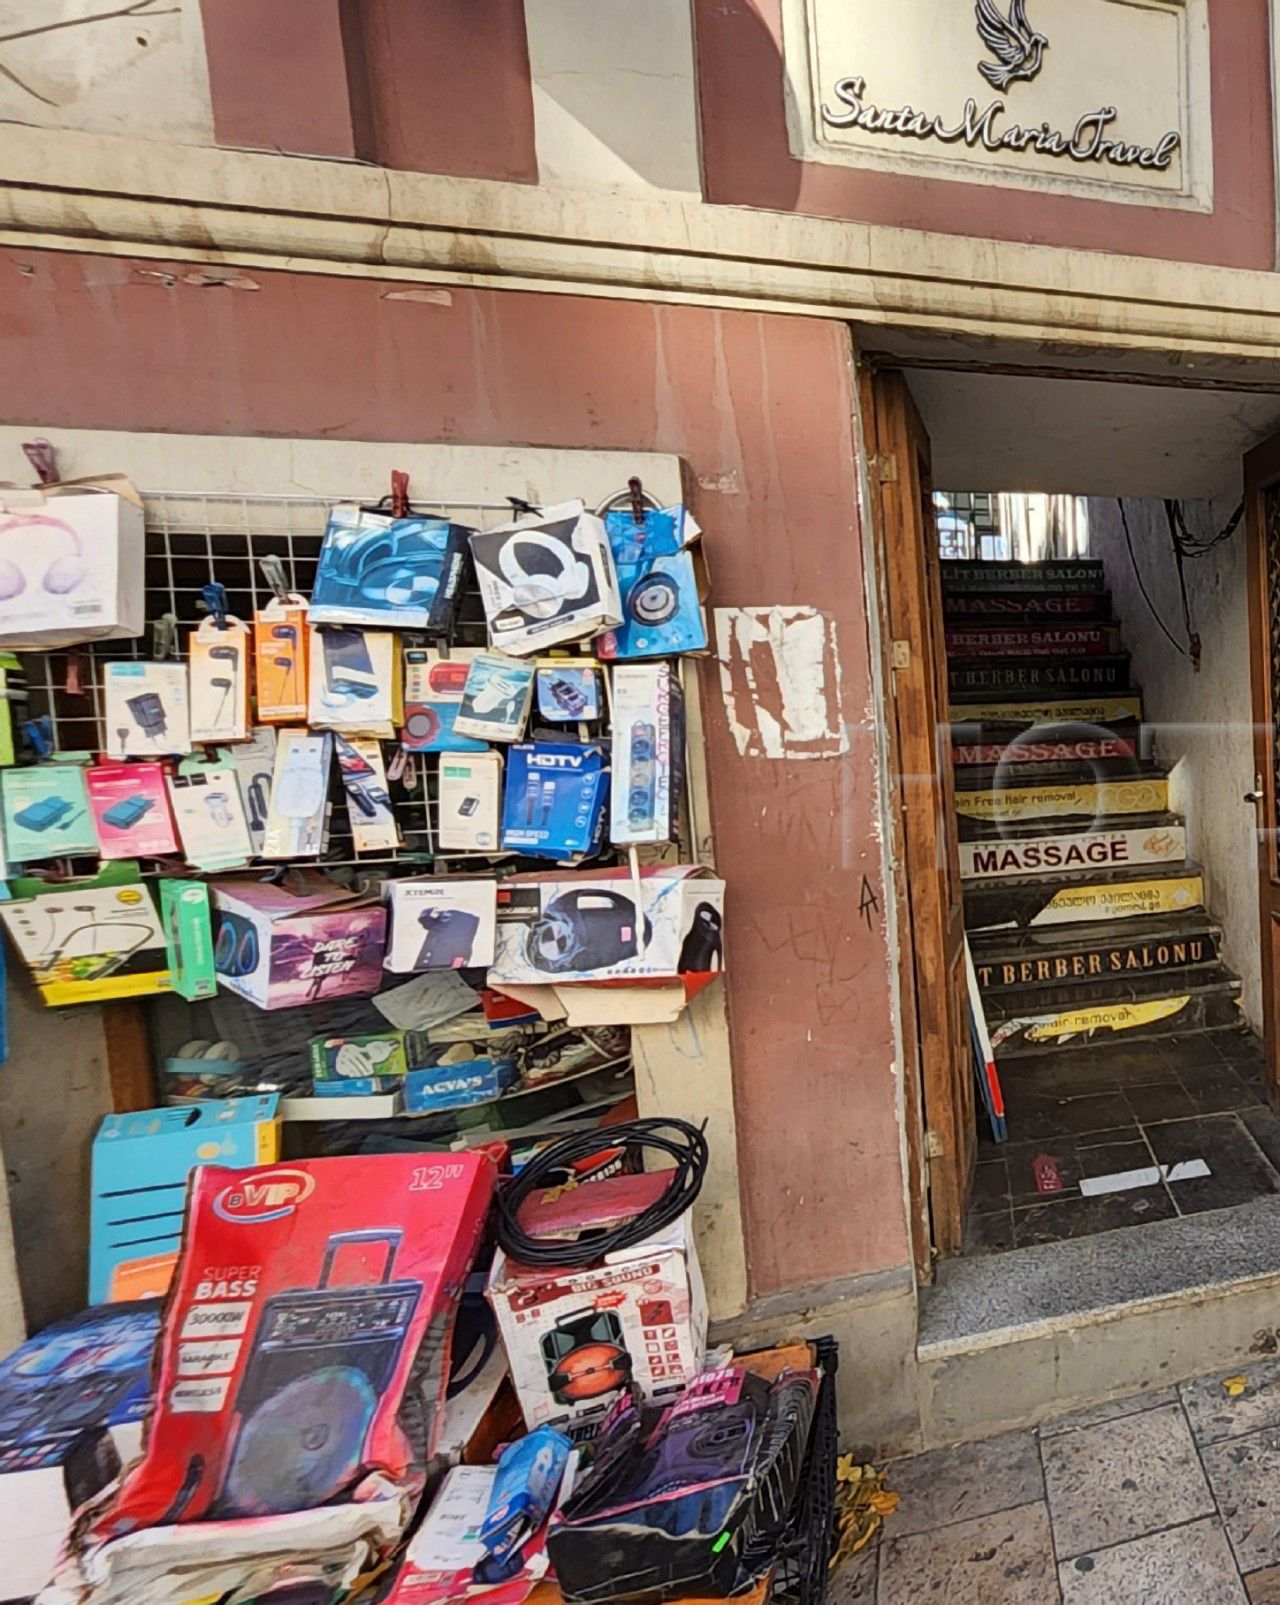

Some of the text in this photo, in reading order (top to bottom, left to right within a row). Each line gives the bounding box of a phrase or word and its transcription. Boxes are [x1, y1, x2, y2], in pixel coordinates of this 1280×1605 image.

[821, 76, 1180, 169] Santa Maria Travel
[973, 568, 1044, 581] BERBER
[946, 597, 1081, 613] MASSAGE
[952, 630, 1100, 645] BERBER SALONU
[965, 669, 1041, 685] BERBER
[1046, 667, 1117, 683] SALONU
[958, 739, 1116, 764] MASSAGE
[526, 753, 583, 767] HDTV
[1005, 792, 1026, 805] hair
[1031, 790, 1076, 804] removal
[973, 839, 1130, 873] MASSAGE
[323, 951, 345, 962] TO
[1002, 953, 1102, 985] BERBER
[1110, 941, 1203, 972] SALONU
[202, 1265, 262, 1281] SUPER
[194, 1280, 258, 1300] BASS
